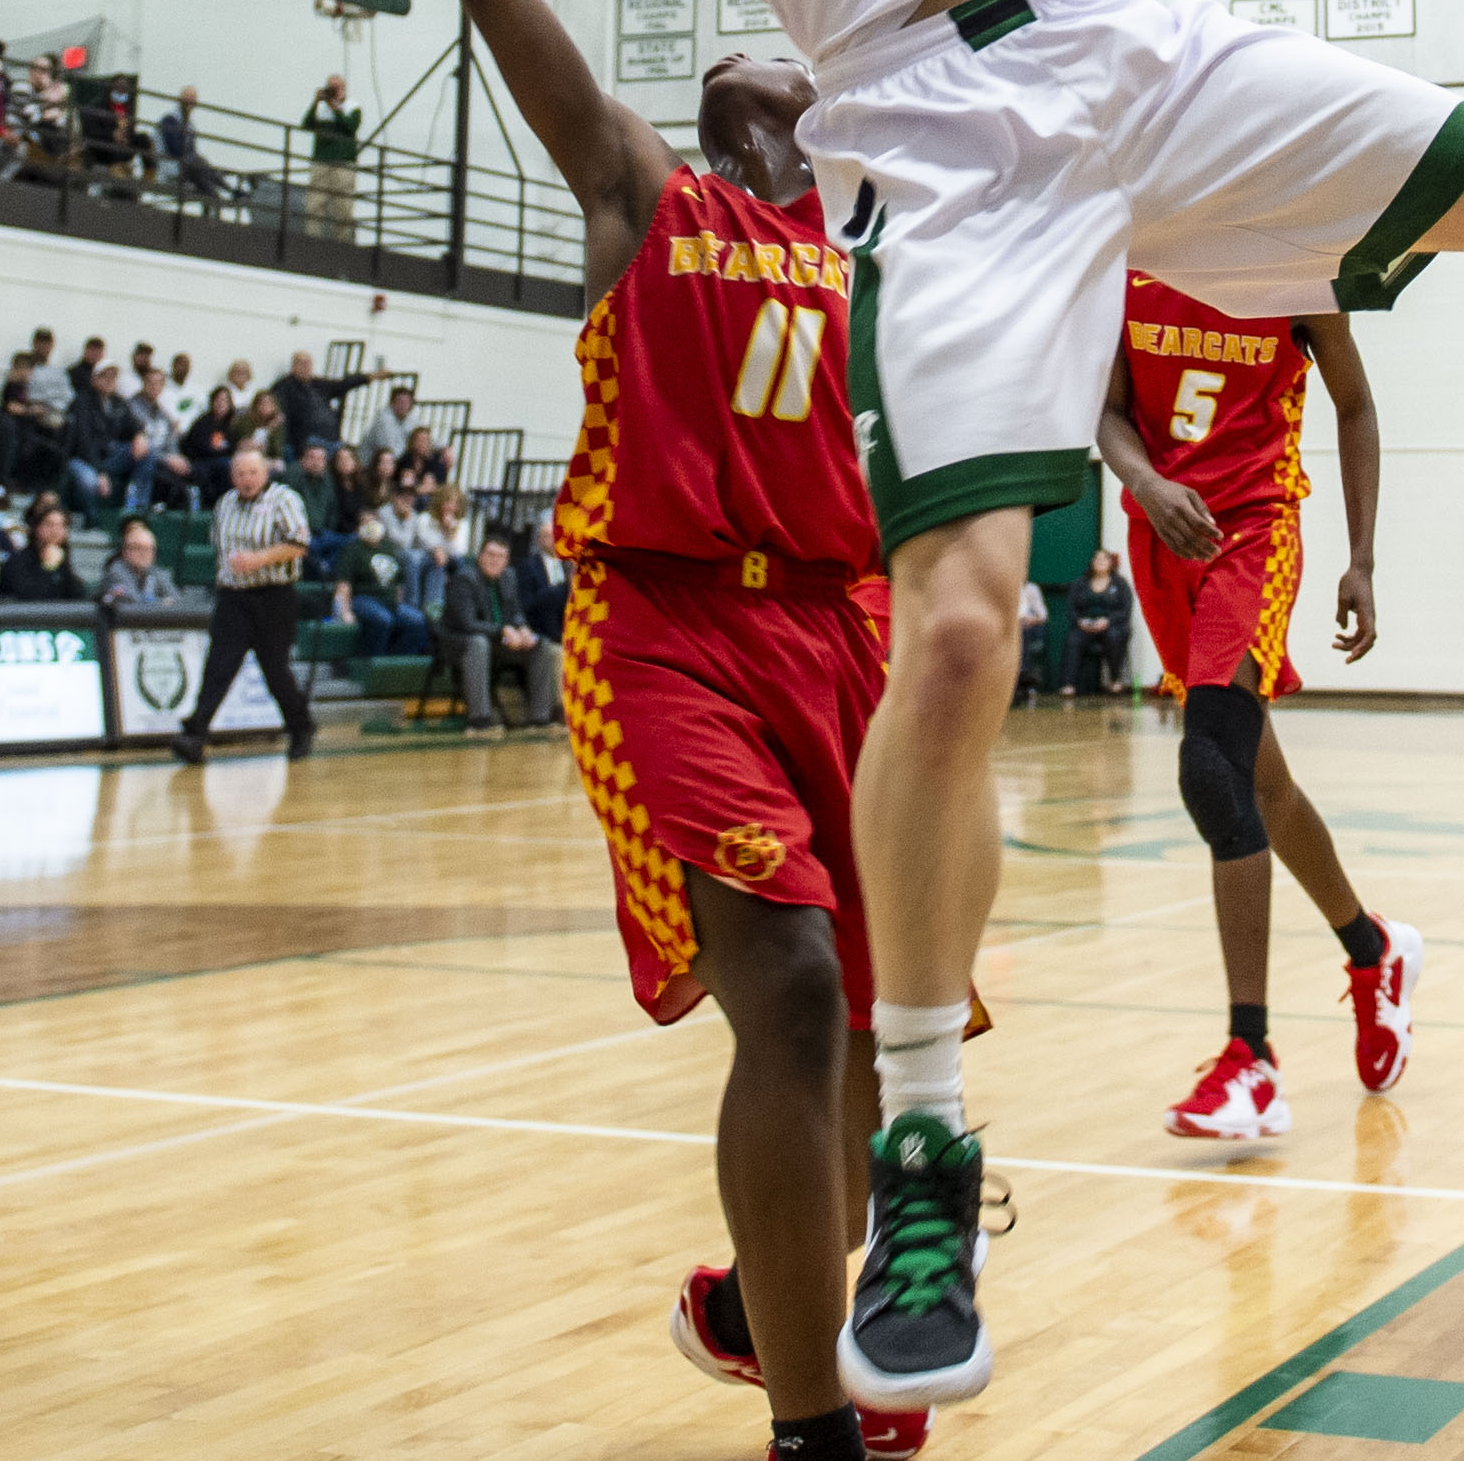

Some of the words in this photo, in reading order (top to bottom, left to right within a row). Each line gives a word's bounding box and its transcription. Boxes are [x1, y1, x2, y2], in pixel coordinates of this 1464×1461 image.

[668, 231, 849, 299] BEARCA
[730, 298, 827, 422] 11
[1128, 321, 1279, 365] BEARCATS
[1169, 369, 1226, 442] 5
